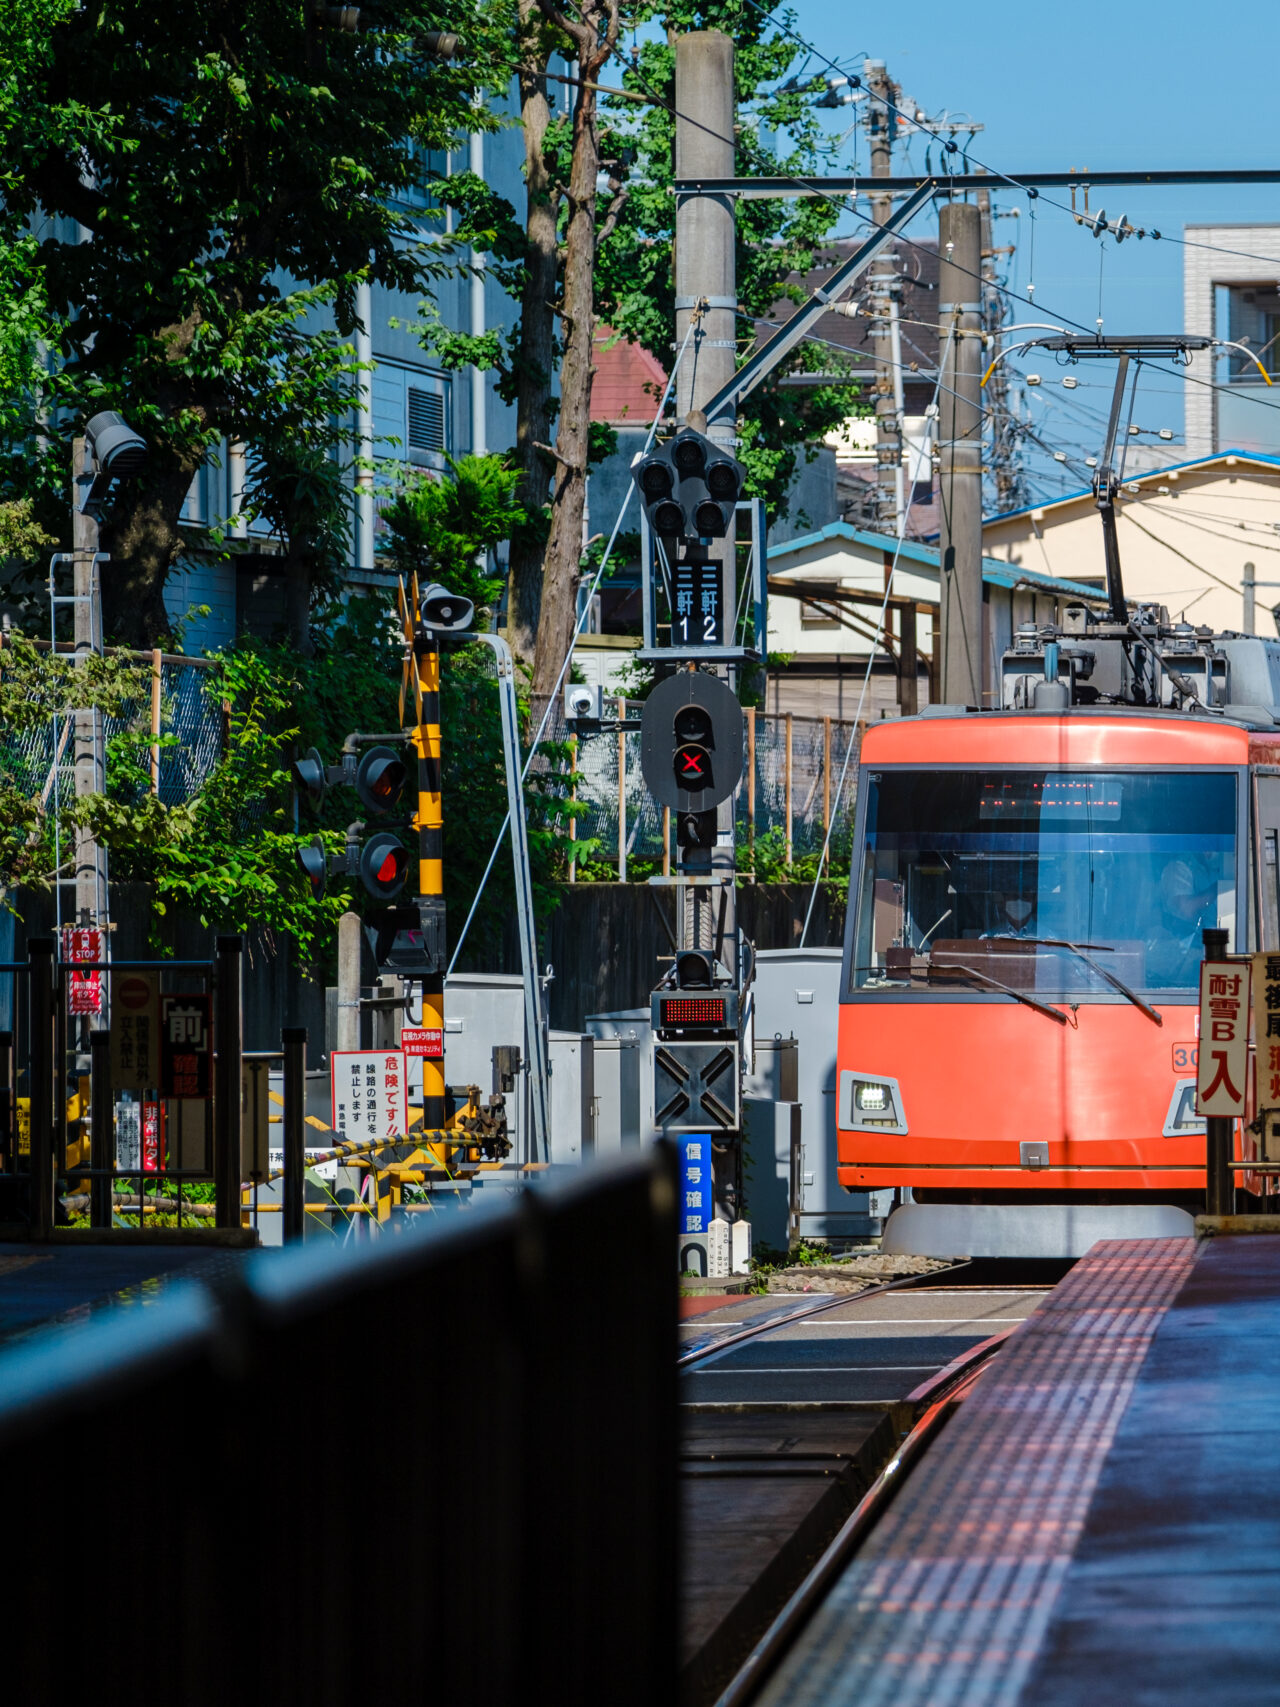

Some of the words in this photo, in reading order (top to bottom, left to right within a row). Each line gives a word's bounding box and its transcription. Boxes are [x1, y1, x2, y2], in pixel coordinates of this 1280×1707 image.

[76, 950, 95, 959] STOP
[1209, 974, 1242, 1041] 耐雪B
[120, 1016, 133, 1070] 立入禁止
[403, 1031, 441, 1041] 監視カメラ作動中
[173, 1054, 199, 1096] 確認
[351, 1064, 361, 1122] 禁止します
[366, 1064, 376, 1134] 線路の通行を
[1201, 1051, 1242, 1103] 入
[686, 1143, 702, 1231] 信号確認
